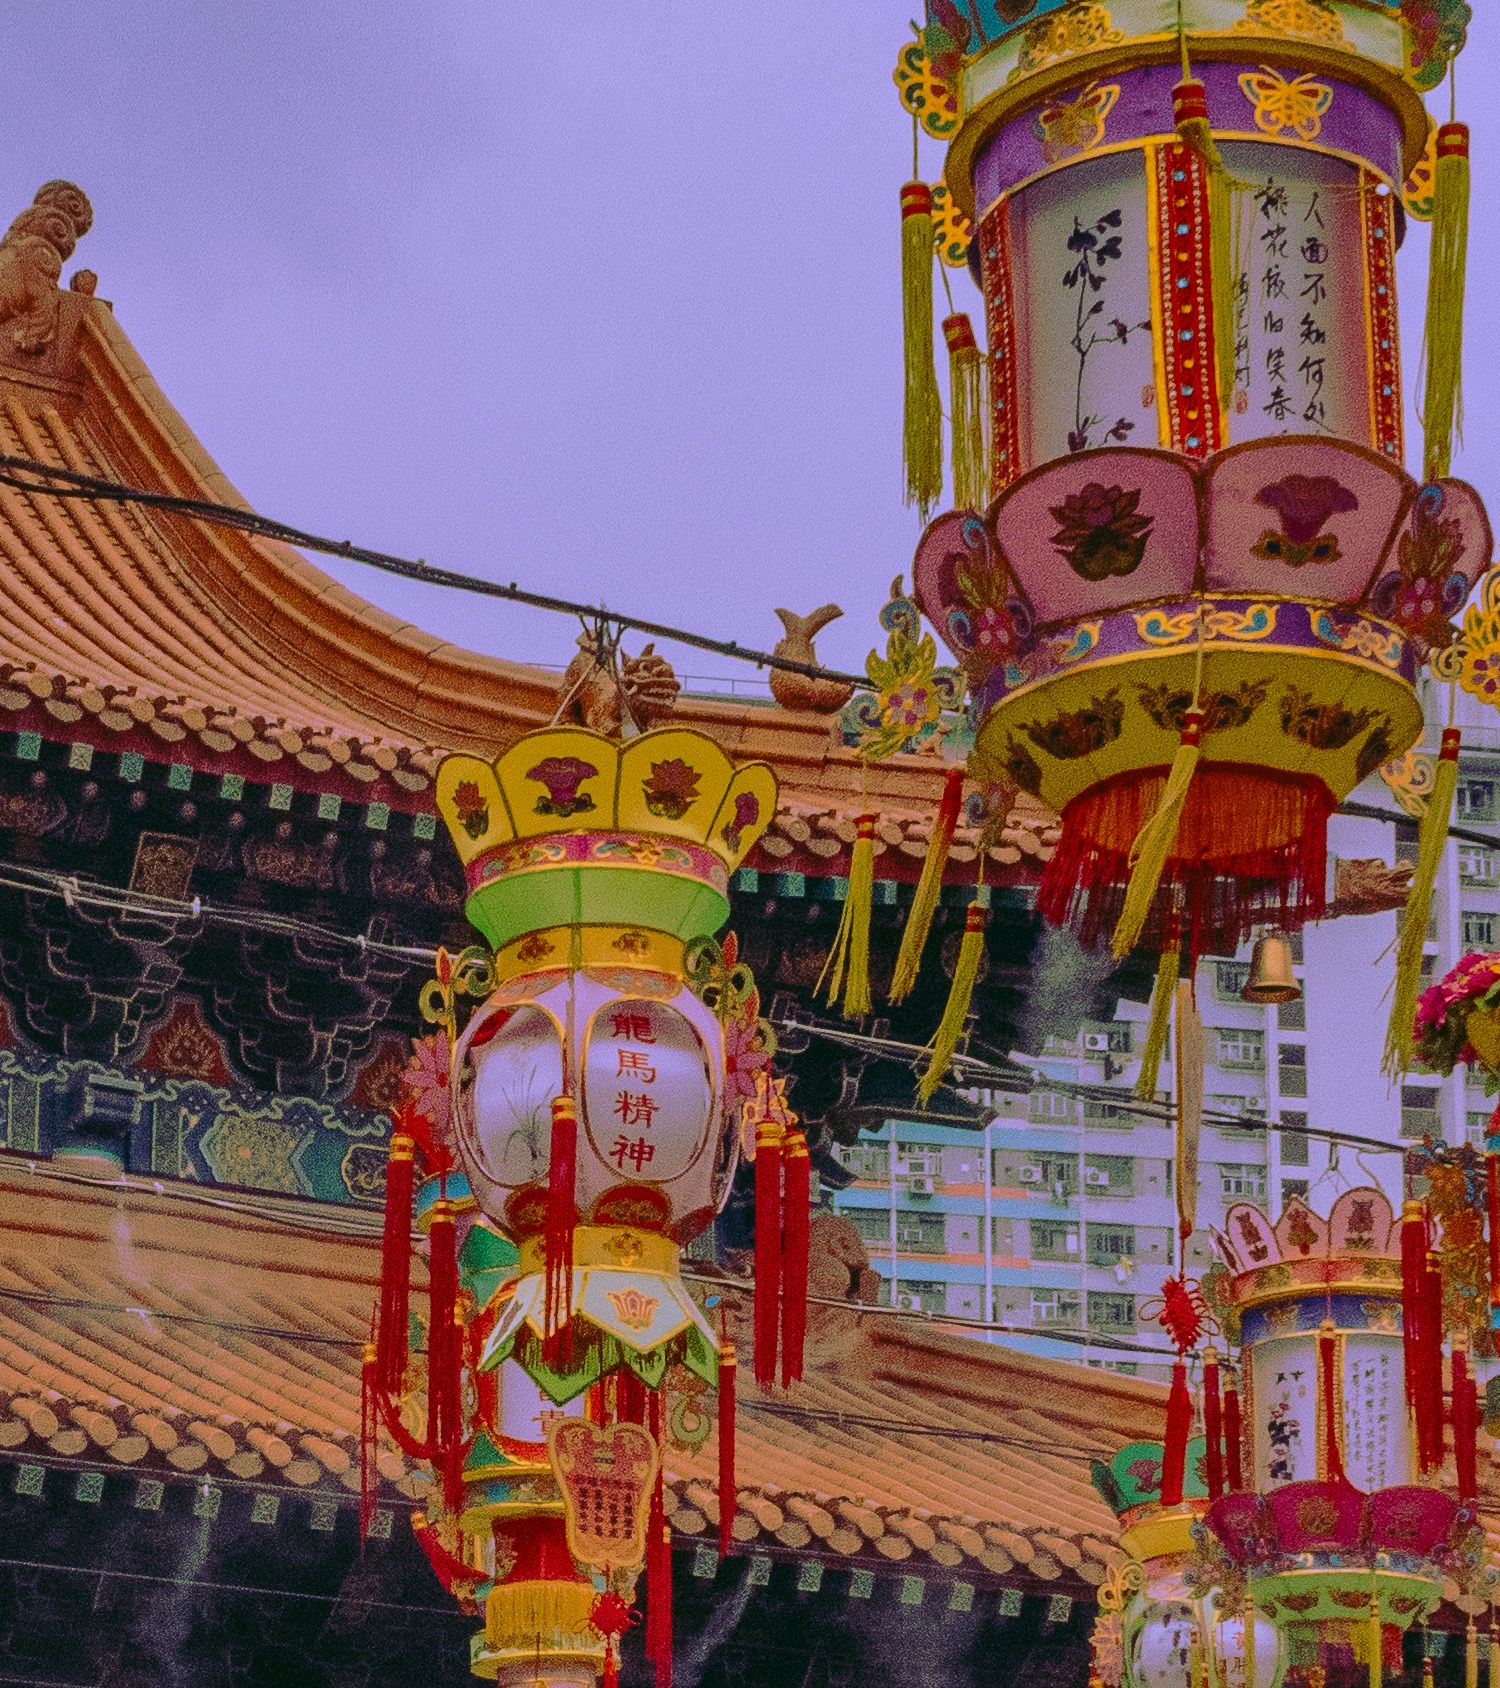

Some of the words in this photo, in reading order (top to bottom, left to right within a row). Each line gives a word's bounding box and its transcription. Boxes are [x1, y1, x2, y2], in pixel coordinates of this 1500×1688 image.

[1299, 191, 1337, 435] 人面不知何处
[608, 1012, 660, 1173] 龍馬精神
